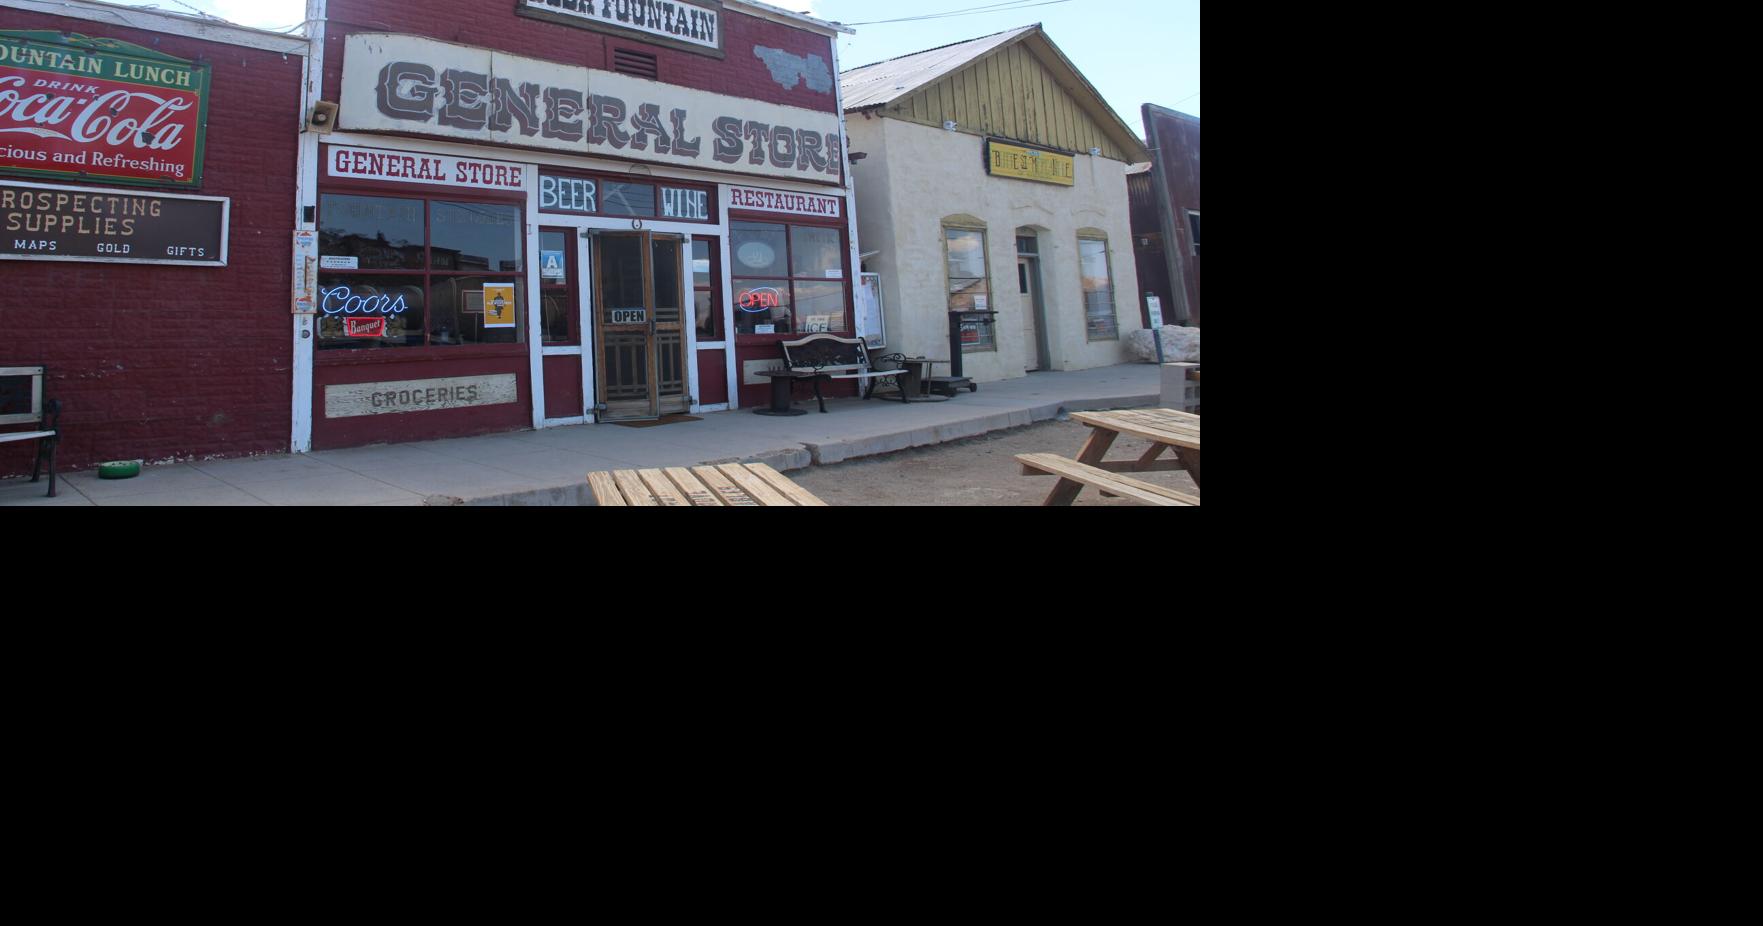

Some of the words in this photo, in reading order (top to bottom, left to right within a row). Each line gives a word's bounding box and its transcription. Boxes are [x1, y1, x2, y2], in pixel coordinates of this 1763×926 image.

[602, 0, 715, 43] FOUNTAIN
[33, 79, 100, 94] DRINK
[114, 62, 191, 87] LUNCH
[0, 76, 193, 150] oca-Cola
[374, 61, 701, 159] GENERAL
[712, 116, 839, 175] STORE
[53, 151, 86, 165] and
[92, 152, 185, 177] Refreshing
[335, 150, 446, 181] GENERAL
[456, 161, 522, 188] STORE
[2, 190, 161, 217] ROSPECTING
[540, 175, 597, 213] BEER
[660, 186, 709, 220] WINE
[731, 188, 837, 215] RESTAURANT
[6, 212, 136, 236] SUPPLIES
[14, 239, 57, 251] MAPS
[96, 243, 131, 254] GOLD
[166, 246, 205, 257] GIFTS
[547, 255, 558, 268] A
[322, 286, 408, 314] Coors
[739, 291, 778, 307] OPEN
[350, 319, 381, 334] Banquet
[613, 309, 645, 323] OPEN
[371, 384, 479, 408] GROCERIES
